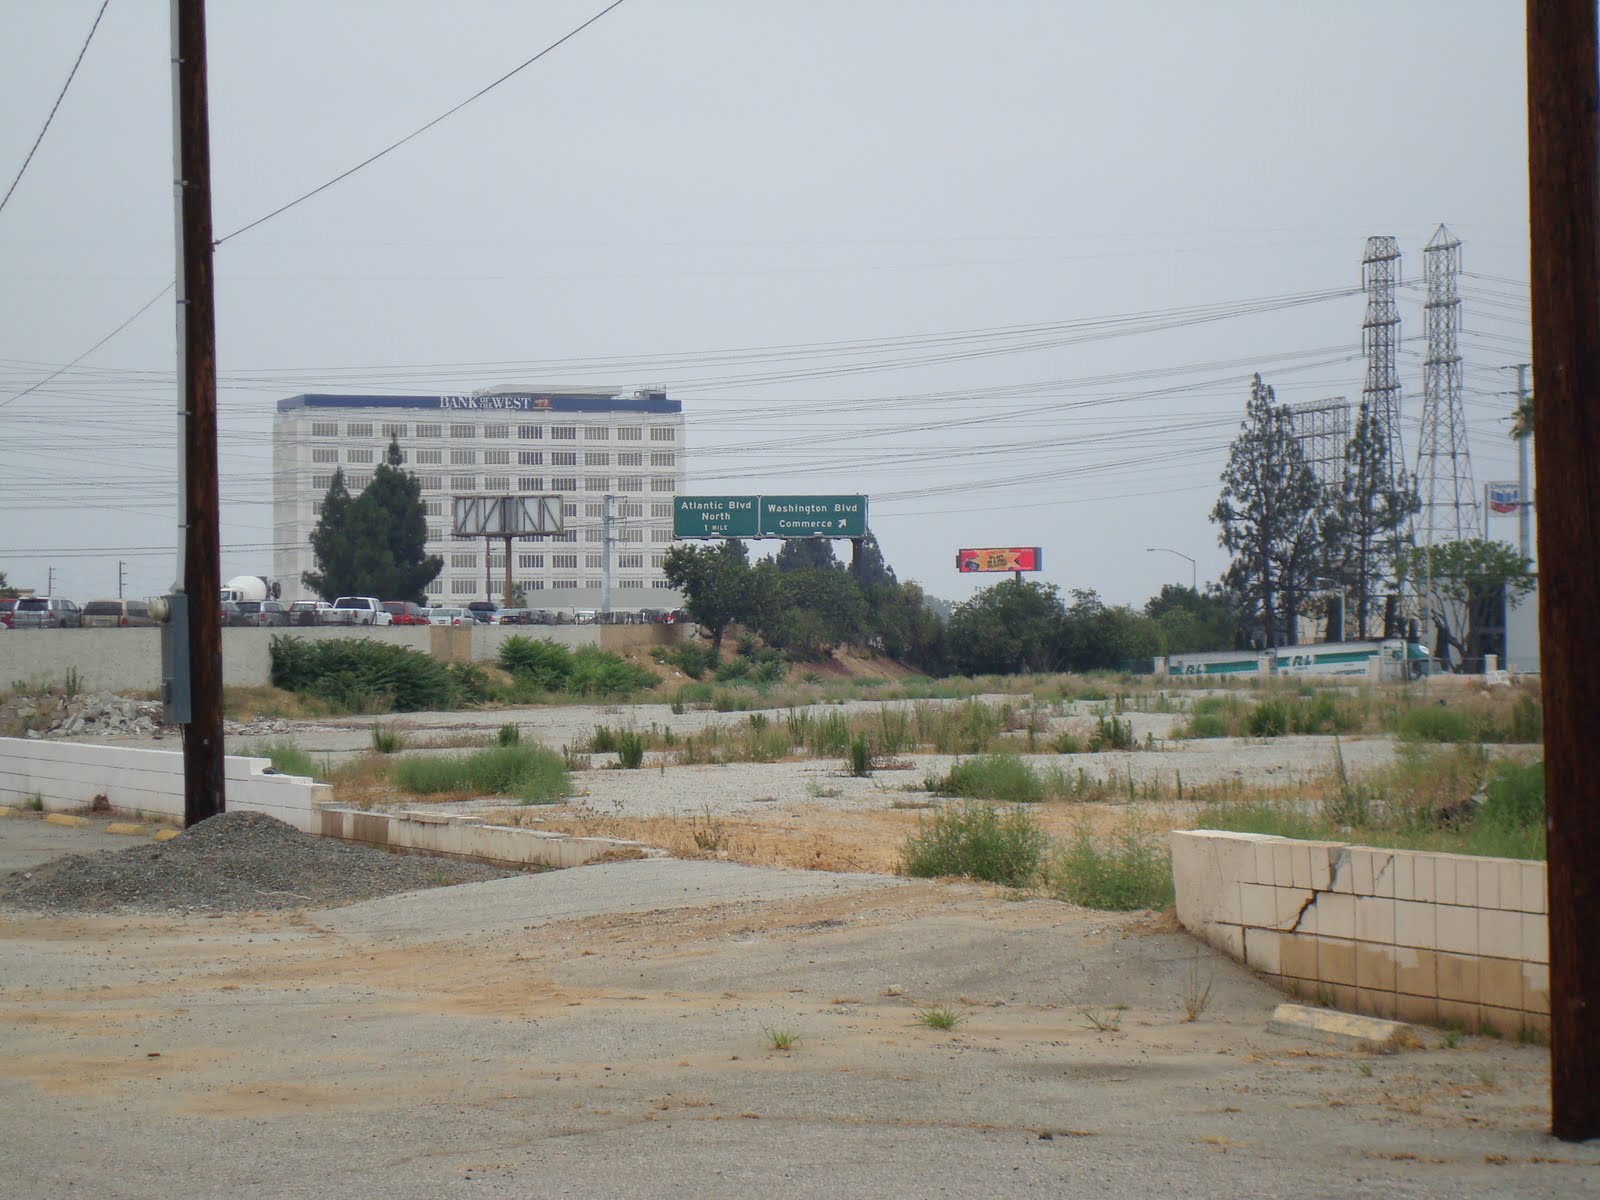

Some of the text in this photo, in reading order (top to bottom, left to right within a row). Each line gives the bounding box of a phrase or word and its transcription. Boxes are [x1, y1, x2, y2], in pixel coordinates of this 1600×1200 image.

[440, 396, 478, 409] BANK
[492, 397, 531, 409] WEST
[681, 501, 752, 510] Atlantic Blvd
[768, 504, 858, 515] Washington Blvd
[701, 512, 731, 520] North
[779, 520, 833, 528] Commerce
